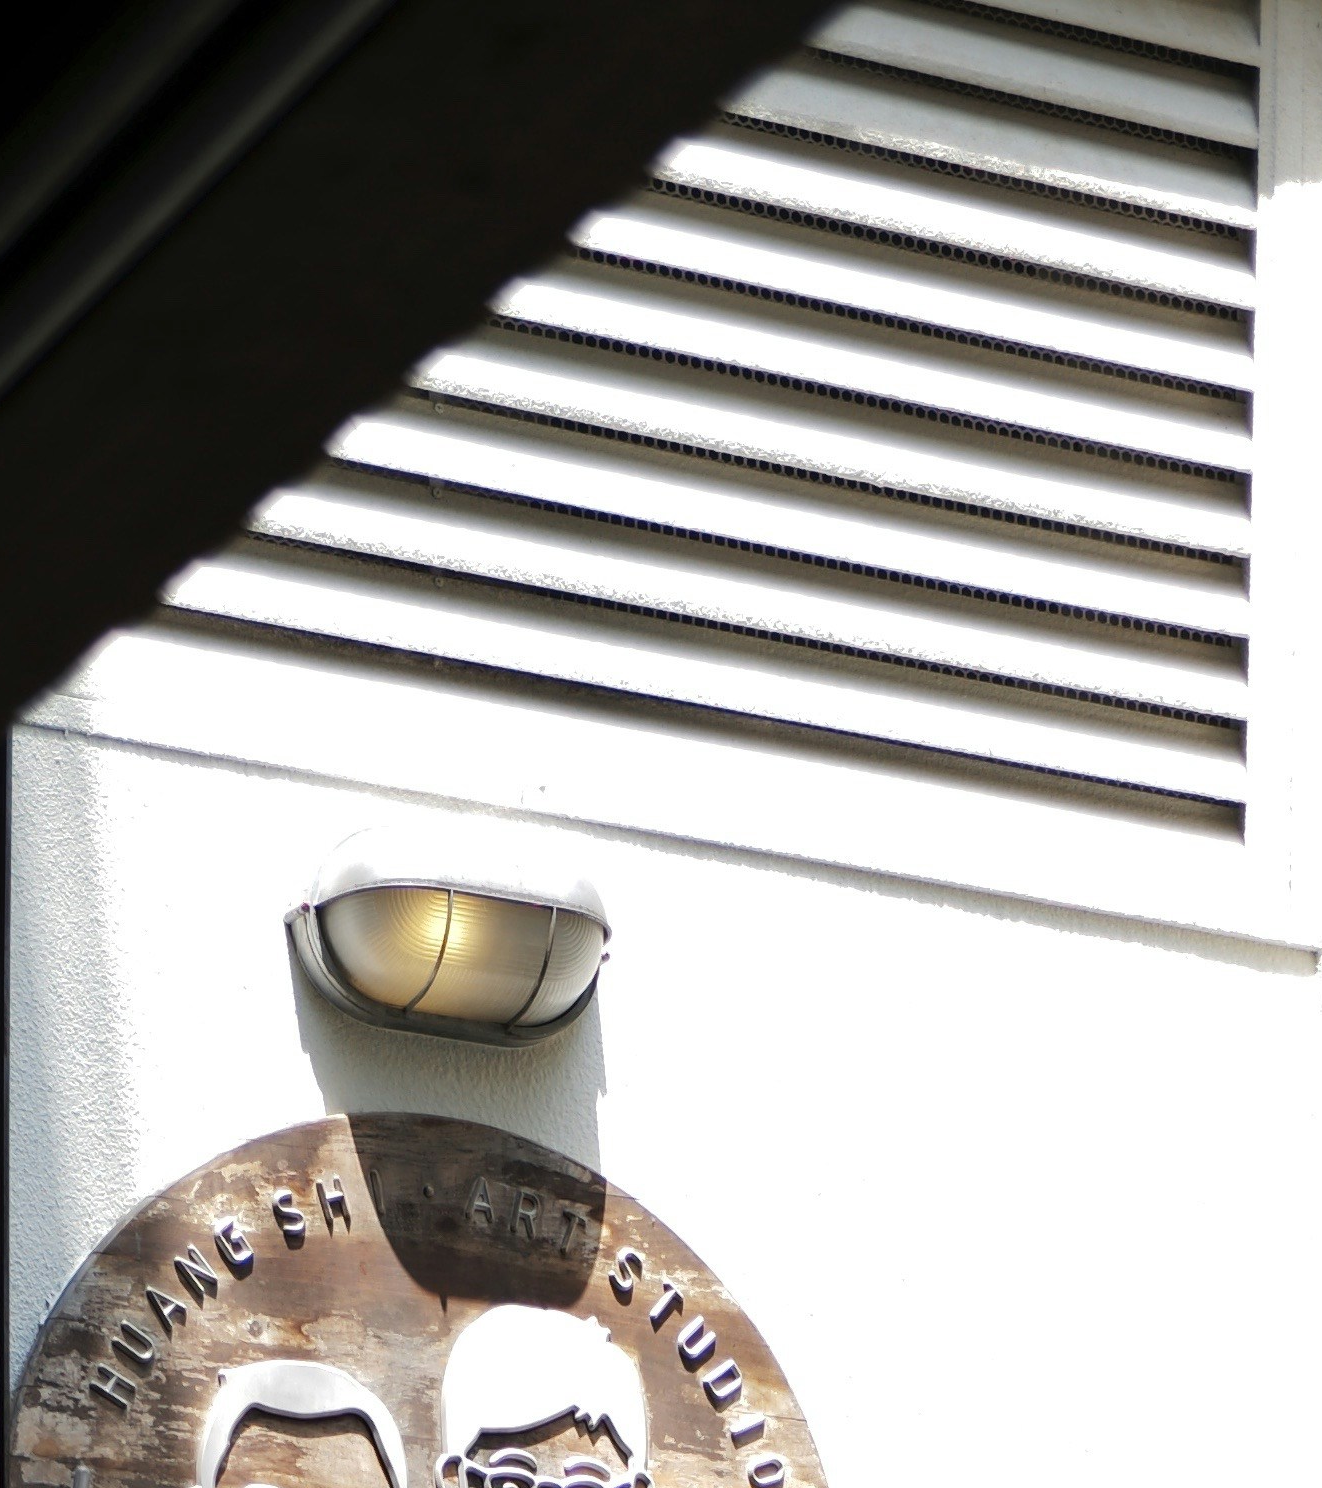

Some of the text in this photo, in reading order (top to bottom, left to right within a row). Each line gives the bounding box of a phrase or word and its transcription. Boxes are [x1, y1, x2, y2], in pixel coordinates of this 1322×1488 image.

[88, 1218, 255, 1411] HUANG
[271, 1167, 386, 1238] SHI
[464, 1175, 587, 1254] ART
